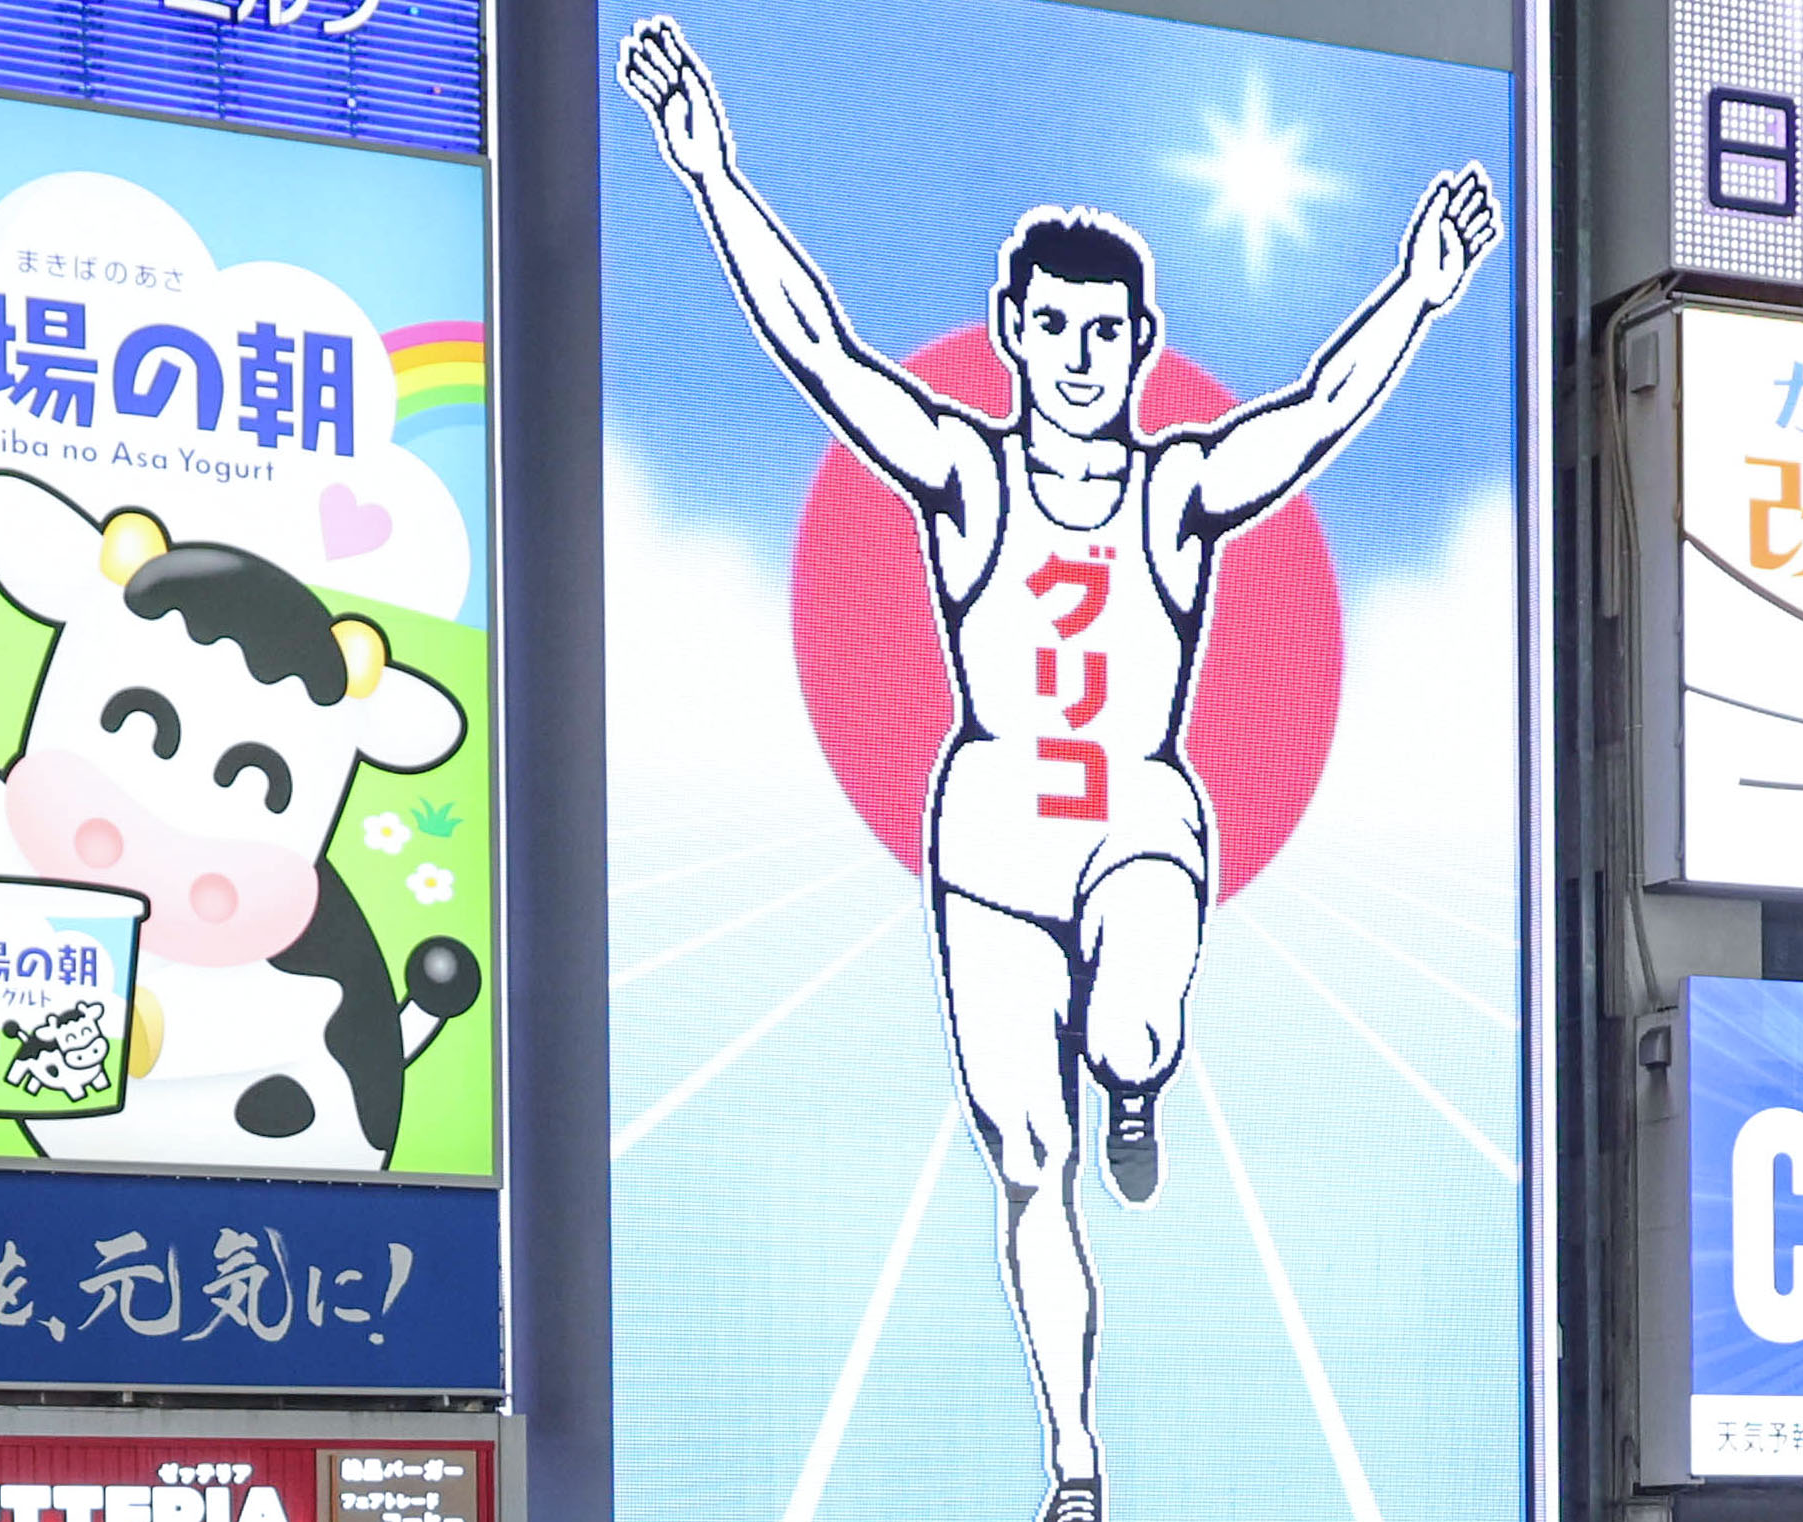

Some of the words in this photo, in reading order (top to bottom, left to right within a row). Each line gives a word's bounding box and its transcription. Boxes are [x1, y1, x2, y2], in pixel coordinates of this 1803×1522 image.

[16, 248, 186, 294] まきばのあさ
[63, 441, 99, 463] no
[112, 439, 169, 471] Asa
[181, 449, 276, 486] Yogurt
[1024, 544, 1117, 823] グリコ
[158, 1462, 254, 1487] ゼッテリア
